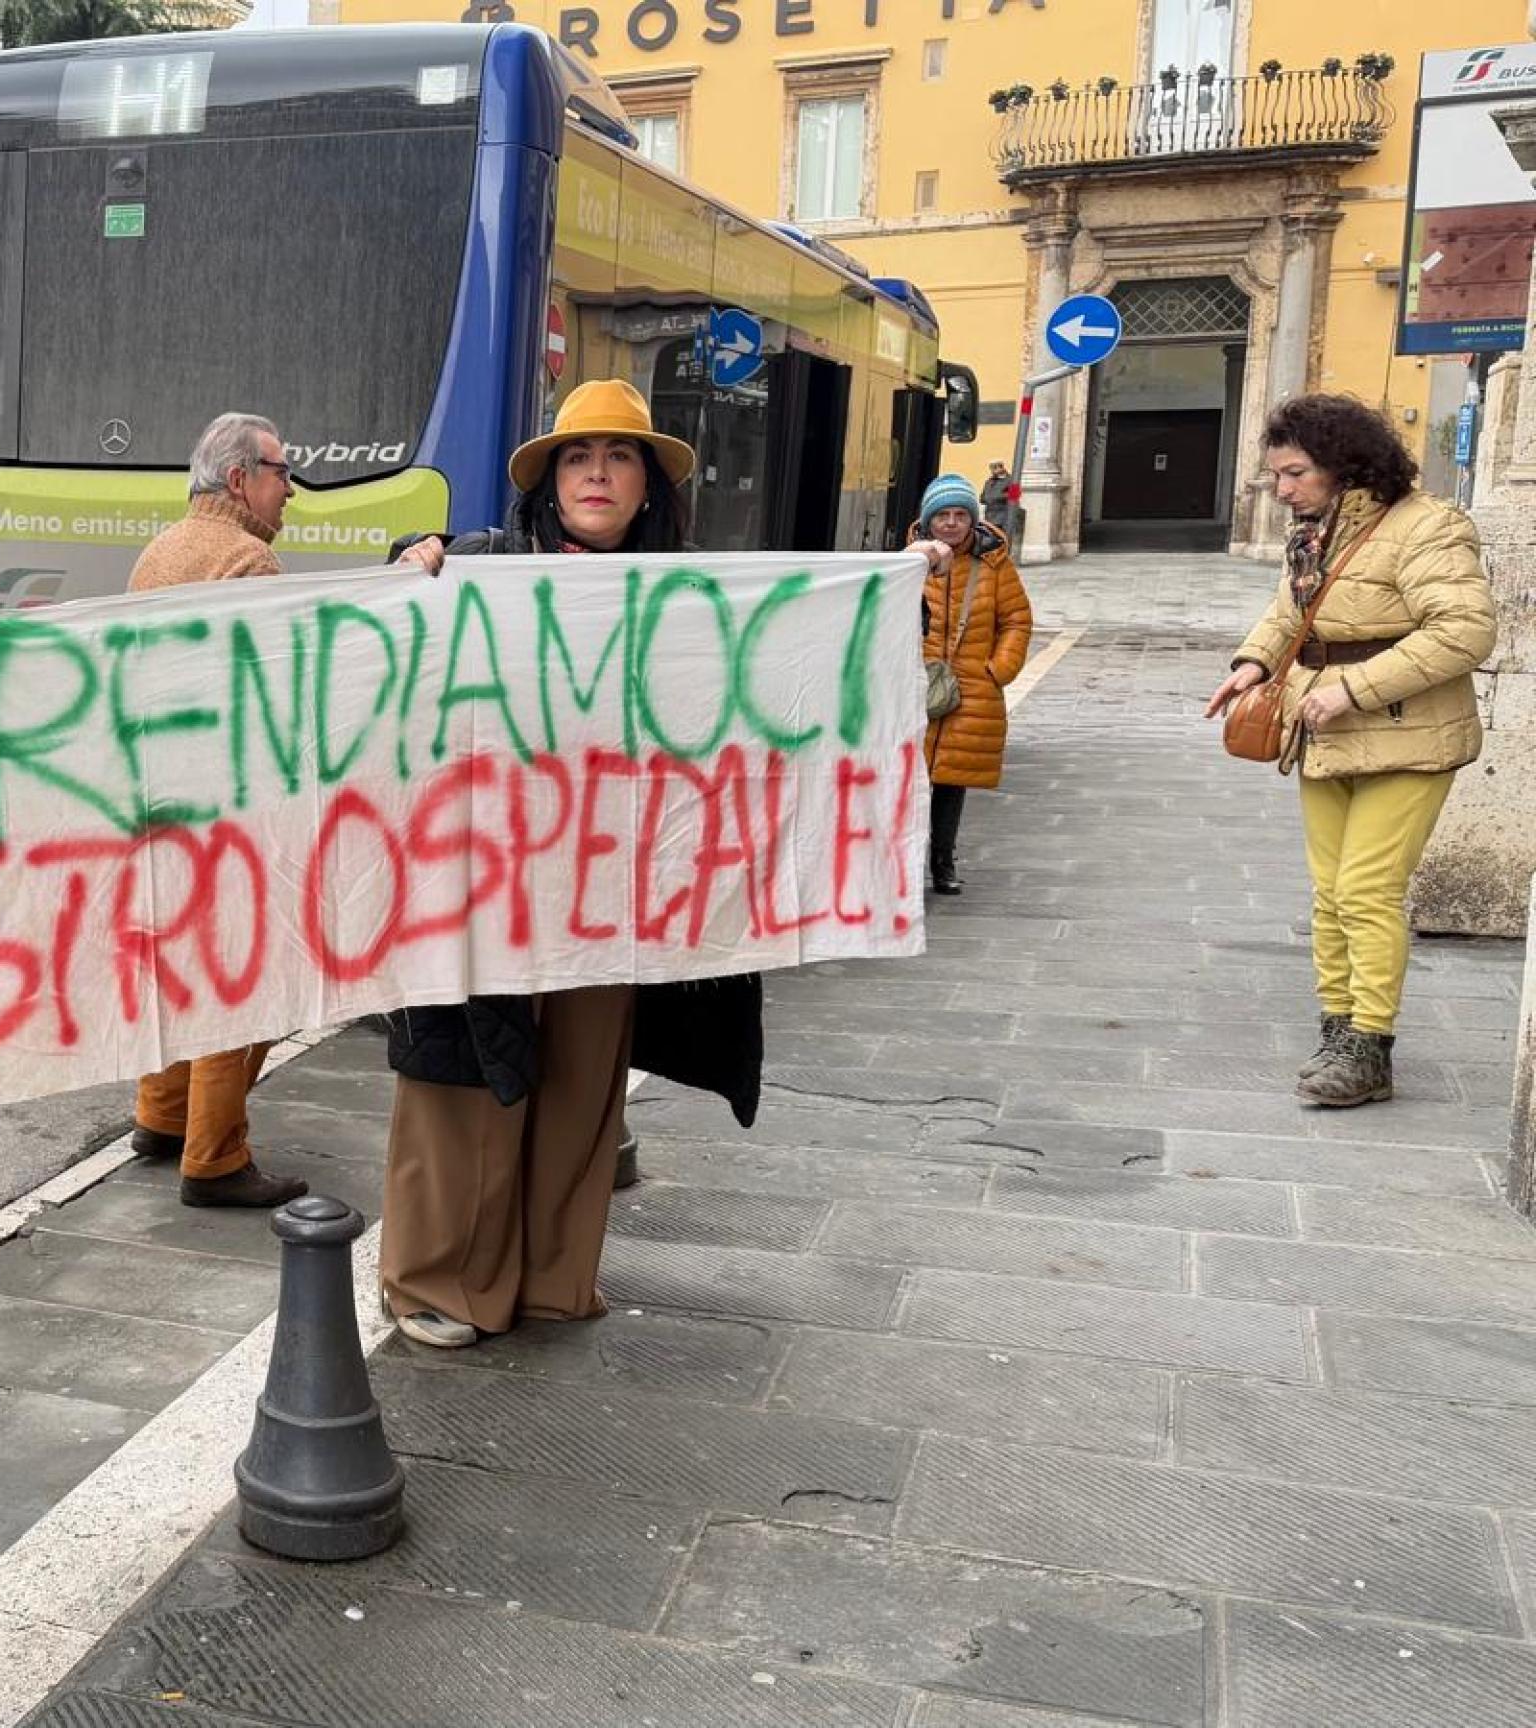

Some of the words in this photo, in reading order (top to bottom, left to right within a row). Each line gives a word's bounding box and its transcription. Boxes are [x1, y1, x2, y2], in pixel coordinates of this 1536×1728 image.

[560, 0, 1035, 57] ROSE
[107, 60, 193, 137] H1
[282, 442, 406, 467] hybrid
[301, 740, 916, 982] OSPEDALE!
